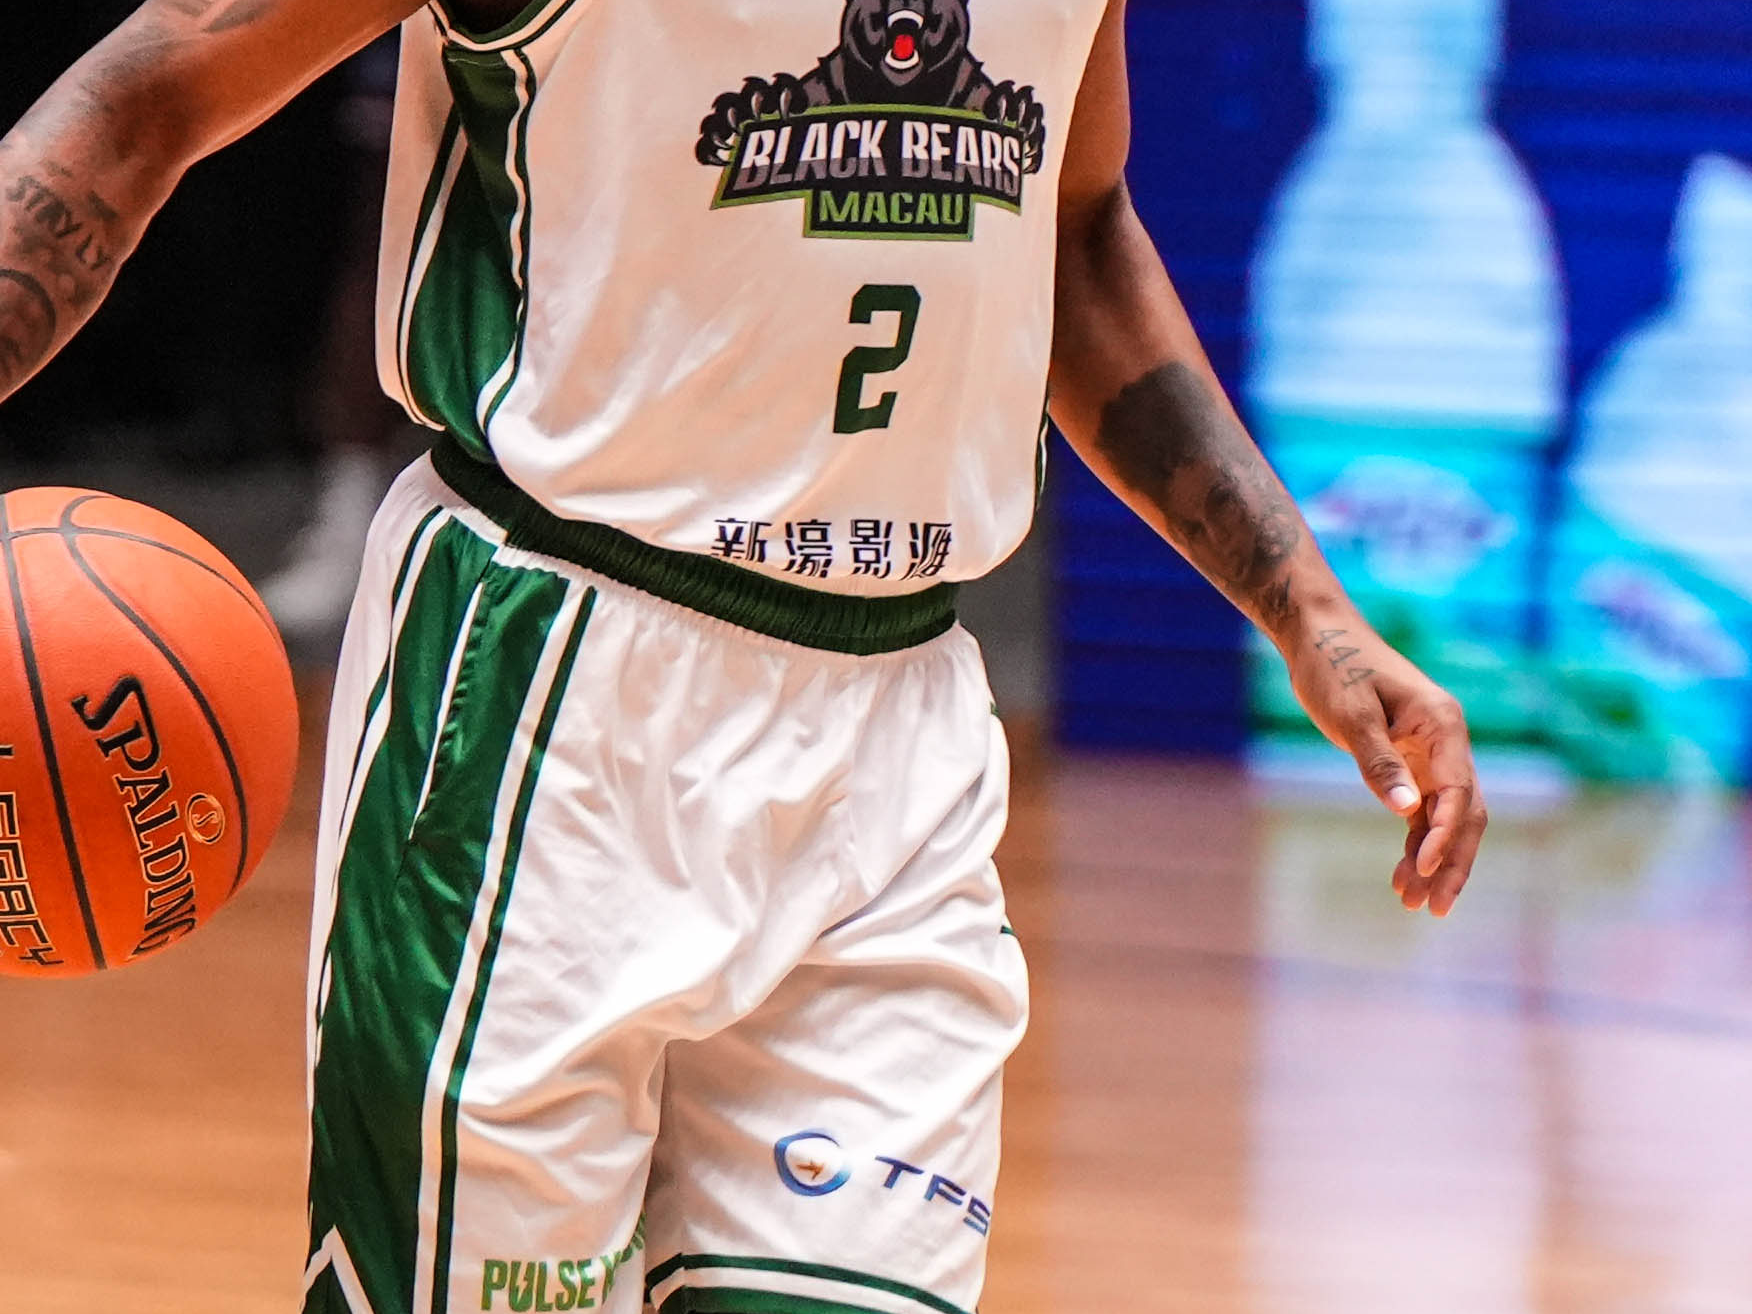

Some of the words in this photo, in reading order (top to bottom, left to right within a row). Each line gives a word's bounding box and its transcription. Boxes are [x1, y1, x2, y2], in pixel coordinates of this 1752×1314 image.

[733, 119, 889, 191] BLACK
[901, 119, 1022, 198] BEARS
[819, 190, 964, 225] MACAU
[833, 283, 922, 435] 2
[71, 675, 198, 960] SPALDING
[480, 1258, 596, 1314] PULSE
